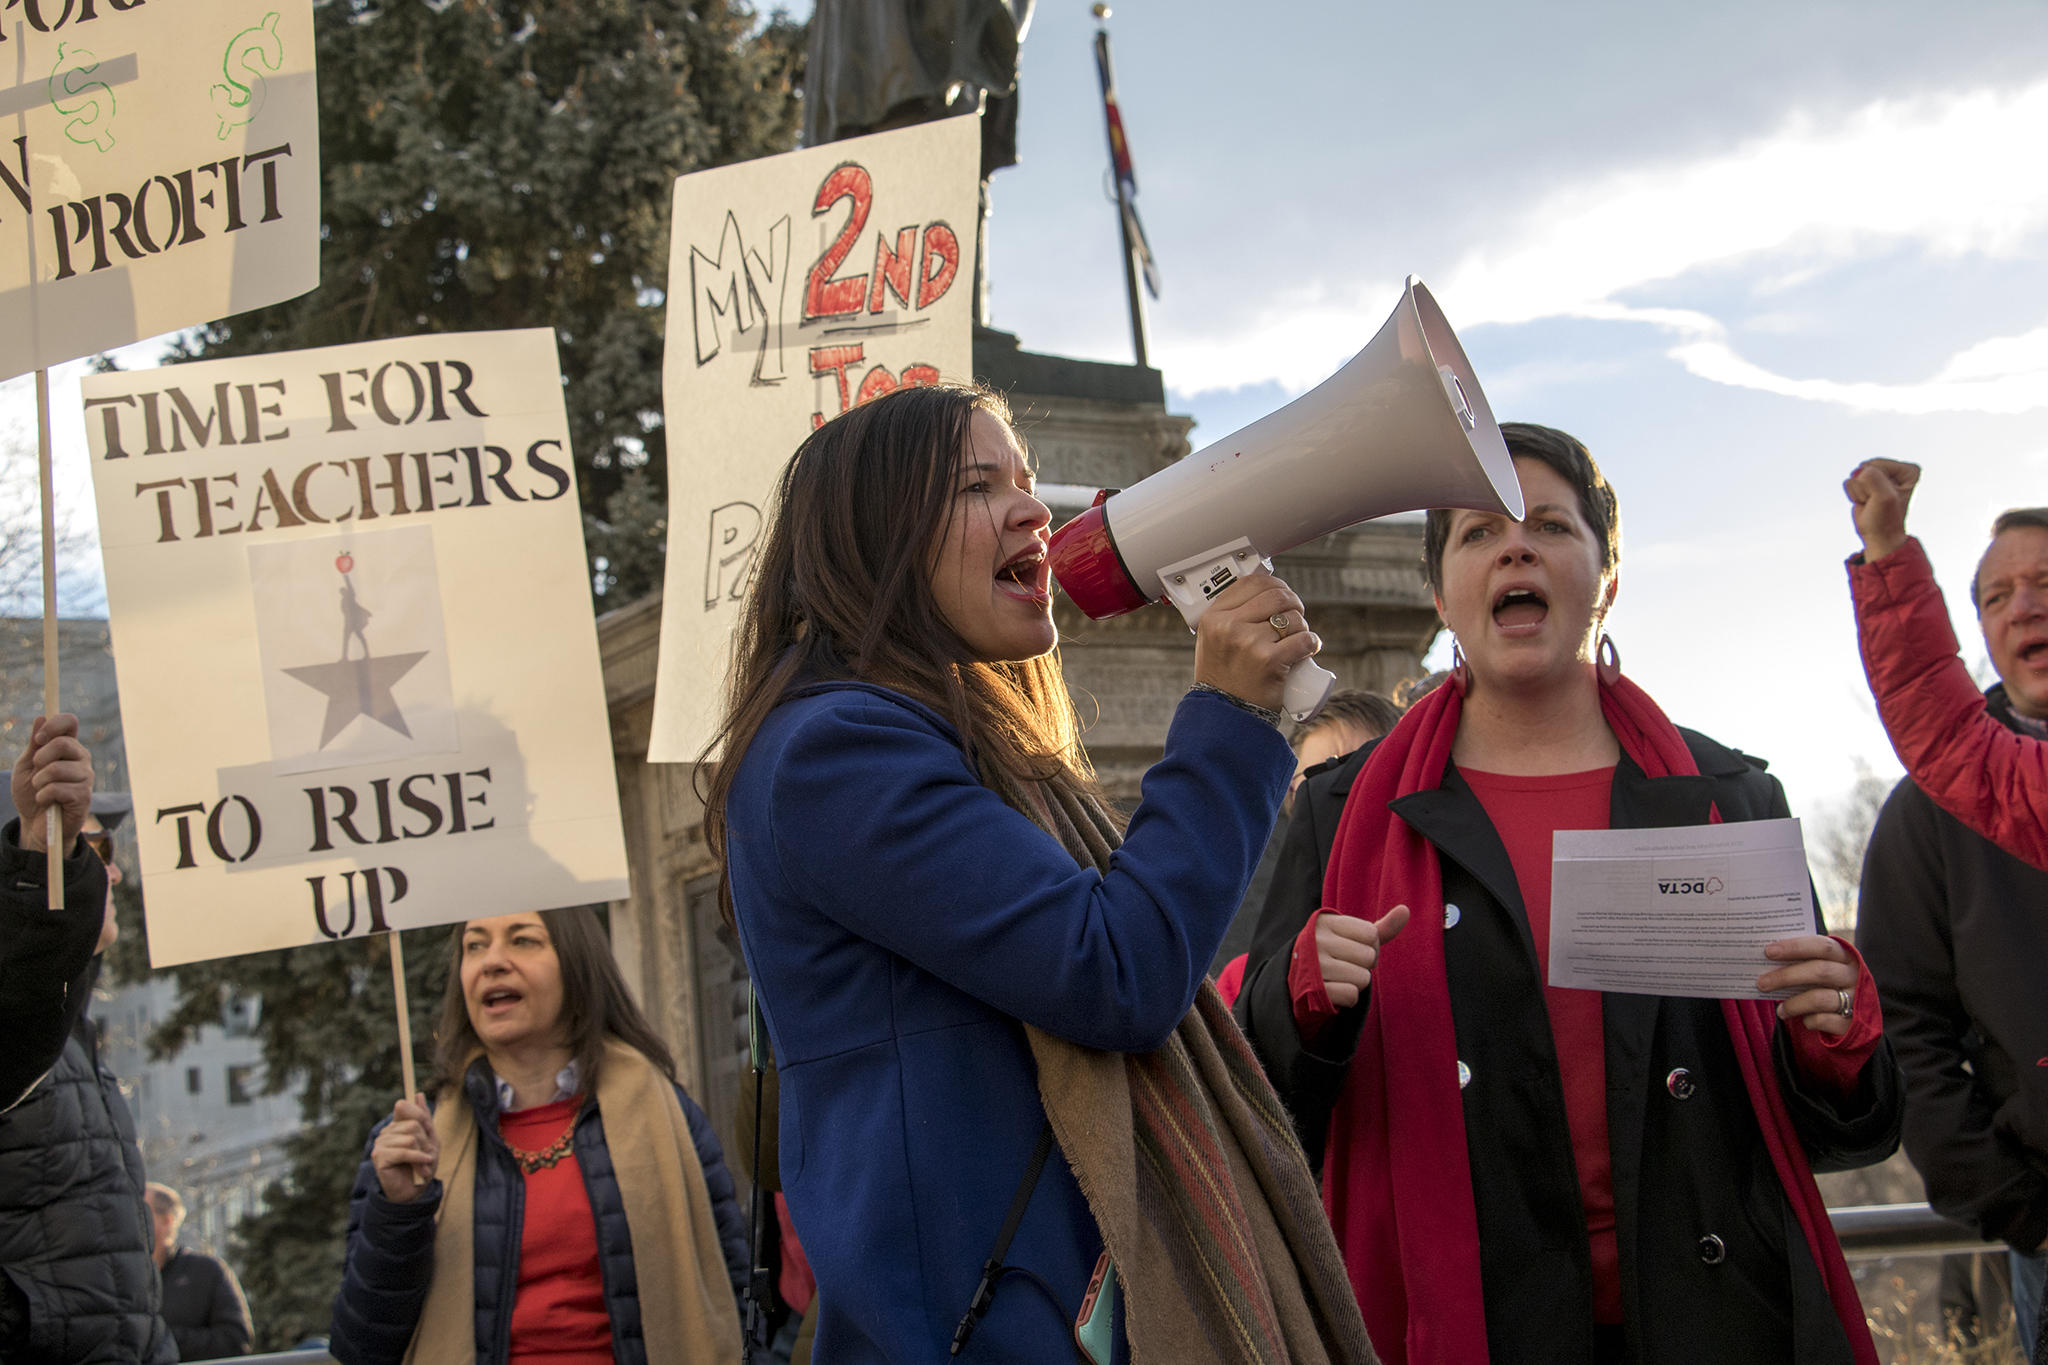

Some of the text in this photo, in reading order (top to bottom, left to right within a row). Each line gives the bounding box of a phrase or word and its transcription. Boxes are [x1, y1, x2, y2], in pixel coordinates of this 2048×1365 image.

[47, 142, 292, 281] PROFIT
[690, 210, 791, 387] MY
[799, 160, 960, 322] 2ND
[84, 360, 489, 460] TIME FOR
[135, 439, 571, 543] TEACHERS
[156, 767, 496, 869] TO RISE
[306, 866, 409, 939] UP
[1658, 882, 1705, 895] DCTA
